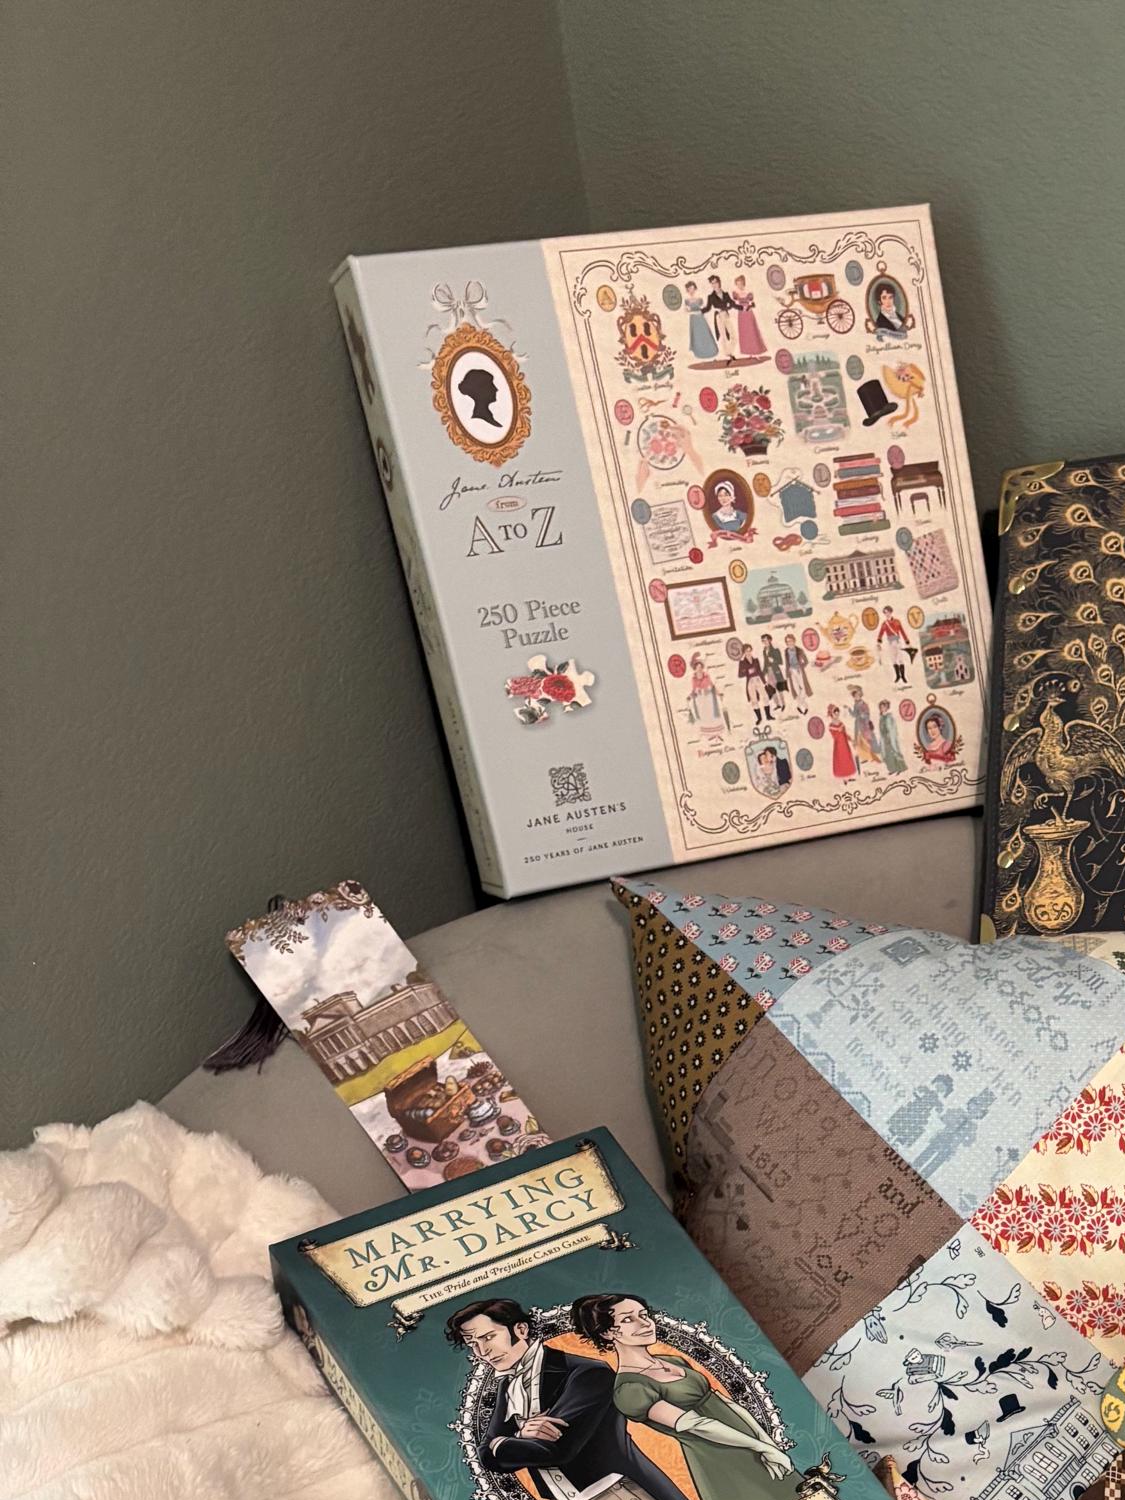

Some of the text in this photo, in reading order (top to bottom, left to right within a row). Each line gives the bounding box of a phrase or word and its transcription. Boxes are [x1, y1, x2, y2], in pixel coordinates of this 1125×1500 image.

[498, 470, 563, 489] Austen
[495, 500, 519, 510] from
[466, 506, 563, 557] A TO Z
[477, 599, 582, 628] 250 Piece
[501, 622, 569, 649] Puzzle
[526, 802, 627, 828] JANE AUSTEN'S
[566, 824, 594, 834] HOUSE
[524, 836, 644, 864] 250 YEARS OF JANE AUSTEN
[344, 1167, 586, 1269] MARRYING
[453, 1188, 600, 1257] DARCY
[443, 1279, 472, 1296] Pride
[472, 1271, 489, 1285] and
[490, 1256, 534, 1278] Prejudice
